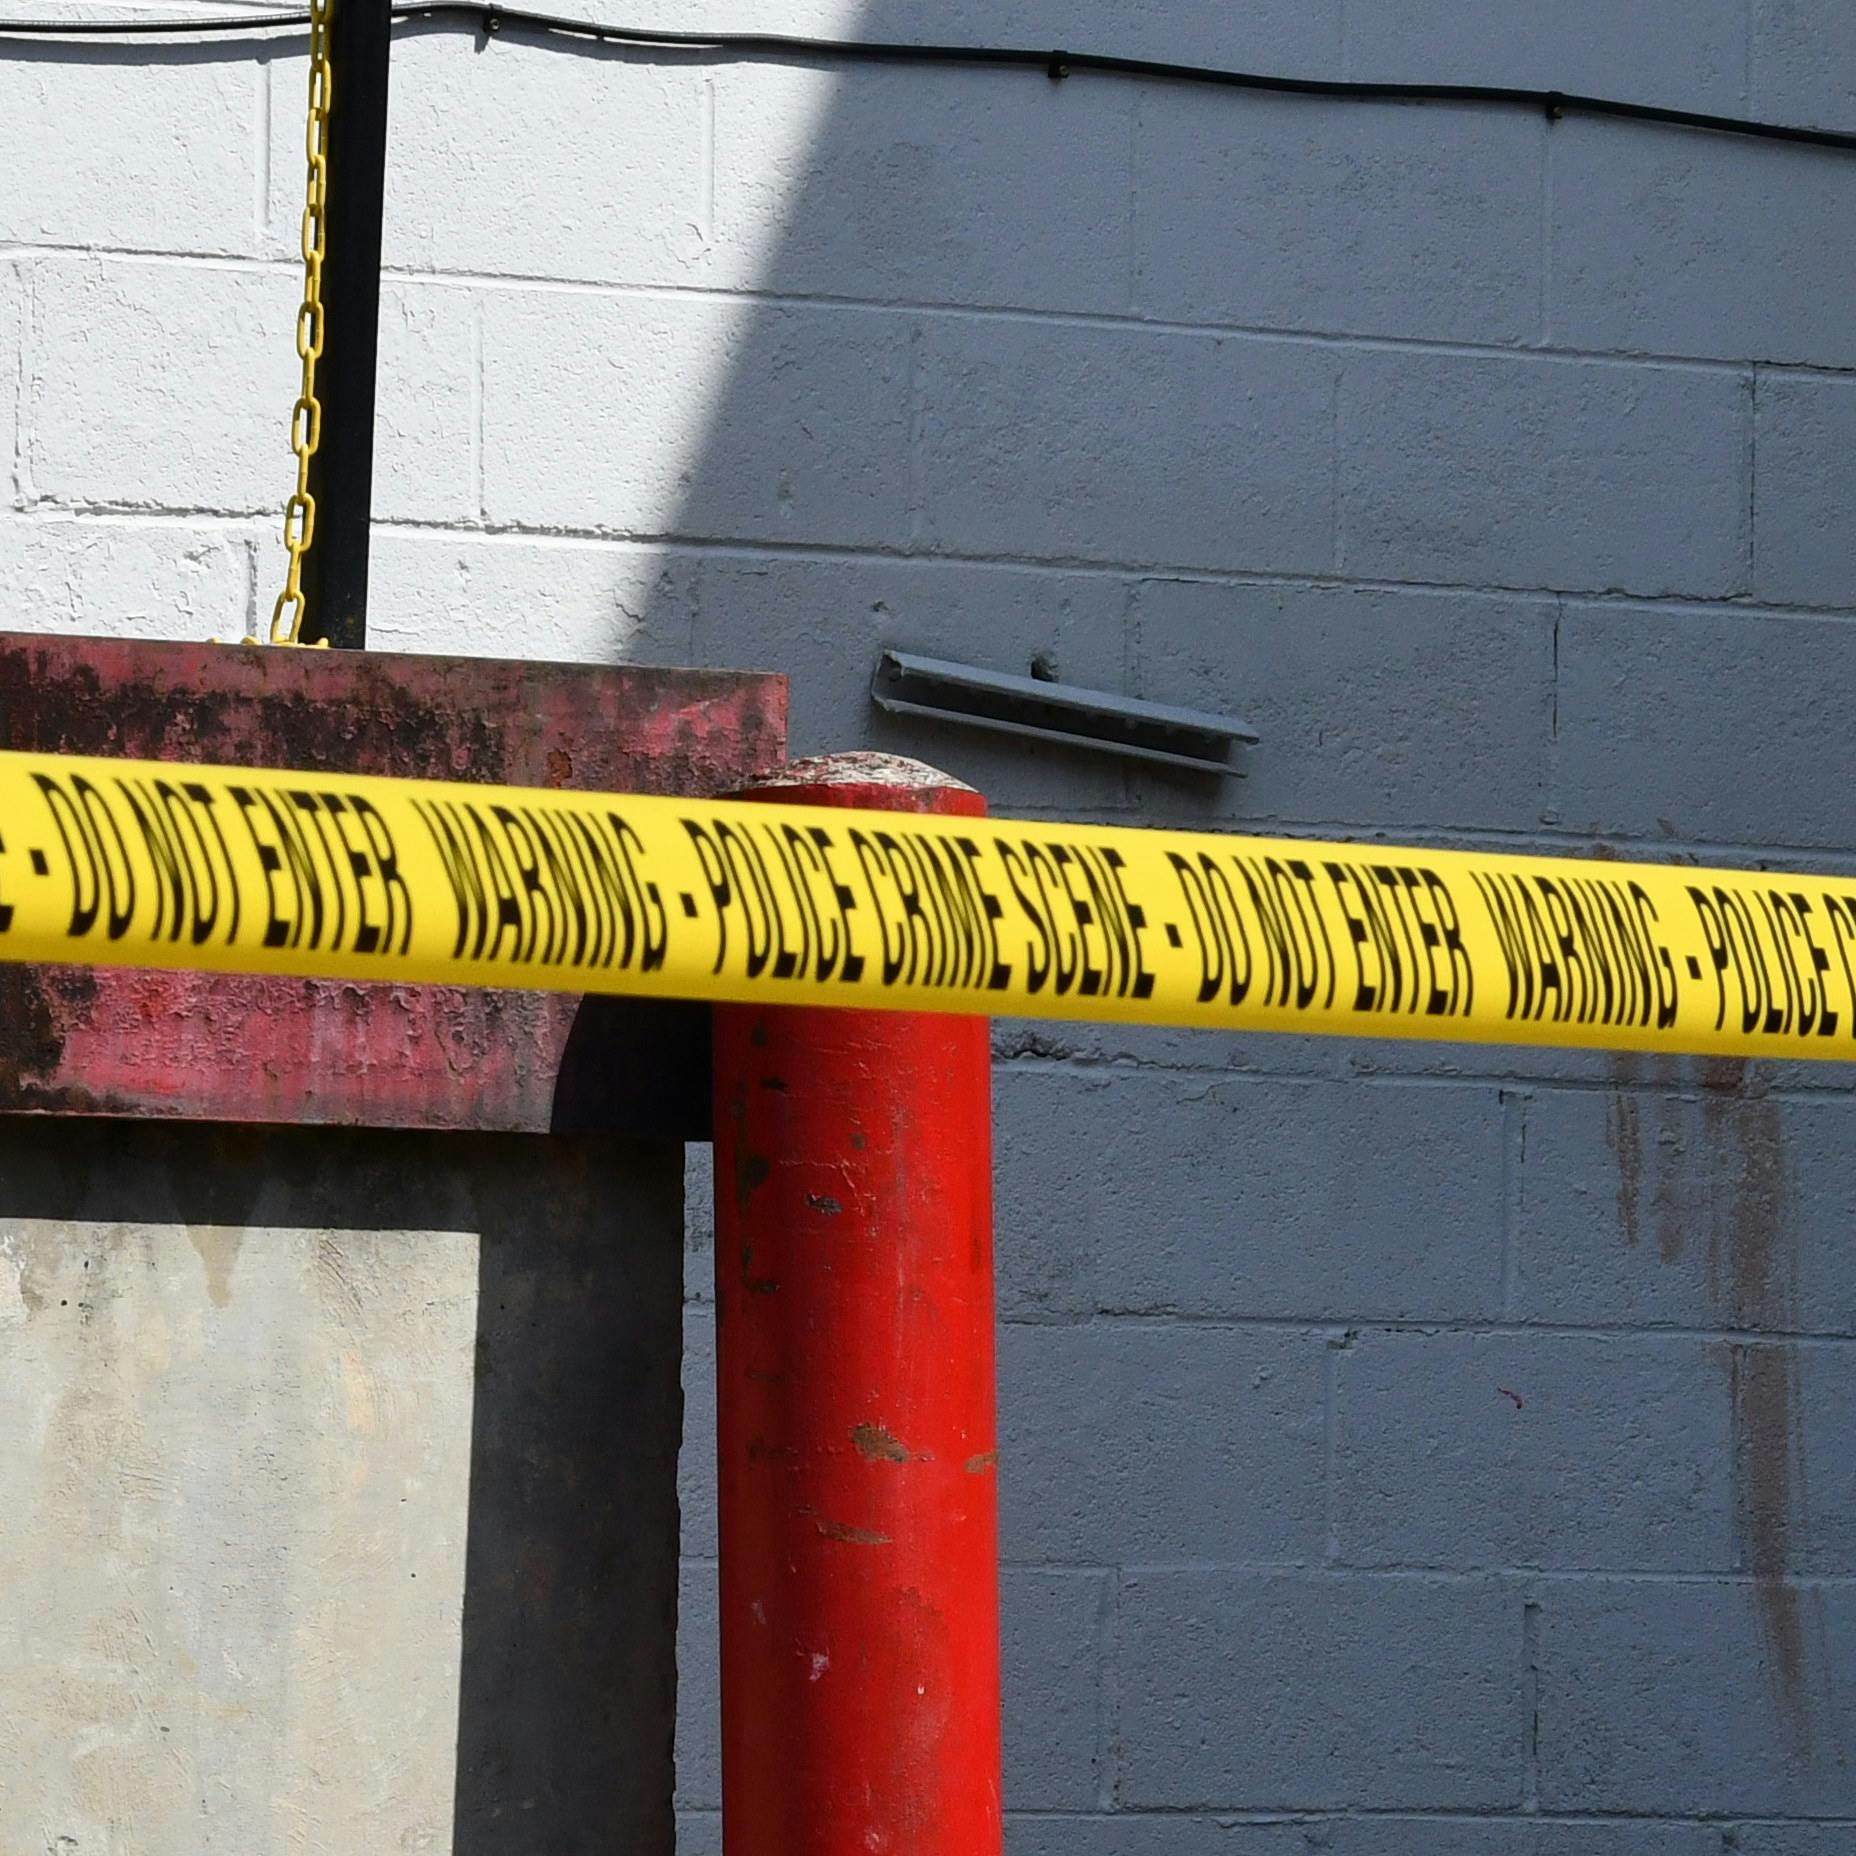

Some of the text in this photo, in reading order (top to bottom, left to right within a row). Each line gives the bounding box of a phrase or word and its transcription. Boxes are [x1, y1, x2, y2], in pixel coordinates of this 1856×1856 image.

[31, 773, 135, 943] DO
[115, 778, 240, 946] NOT
[227, 786, 412, 956] ENTER
[410, 799, 667, 973] WARNING
[680, 818, 864, 984] POLICE
[848, 828, 1011, 991] CRIME
[995, 838, 1155, 1000] SCENE
[1166, 852, 1251, 1006] DO
[1233, 857, 1335, 1010] NOT
[1322, 862, 1473, 1017] ENTER
[1469, 871, 1677, 1030] WARNING
[1685, 886, 1838, 1037] POLICE
